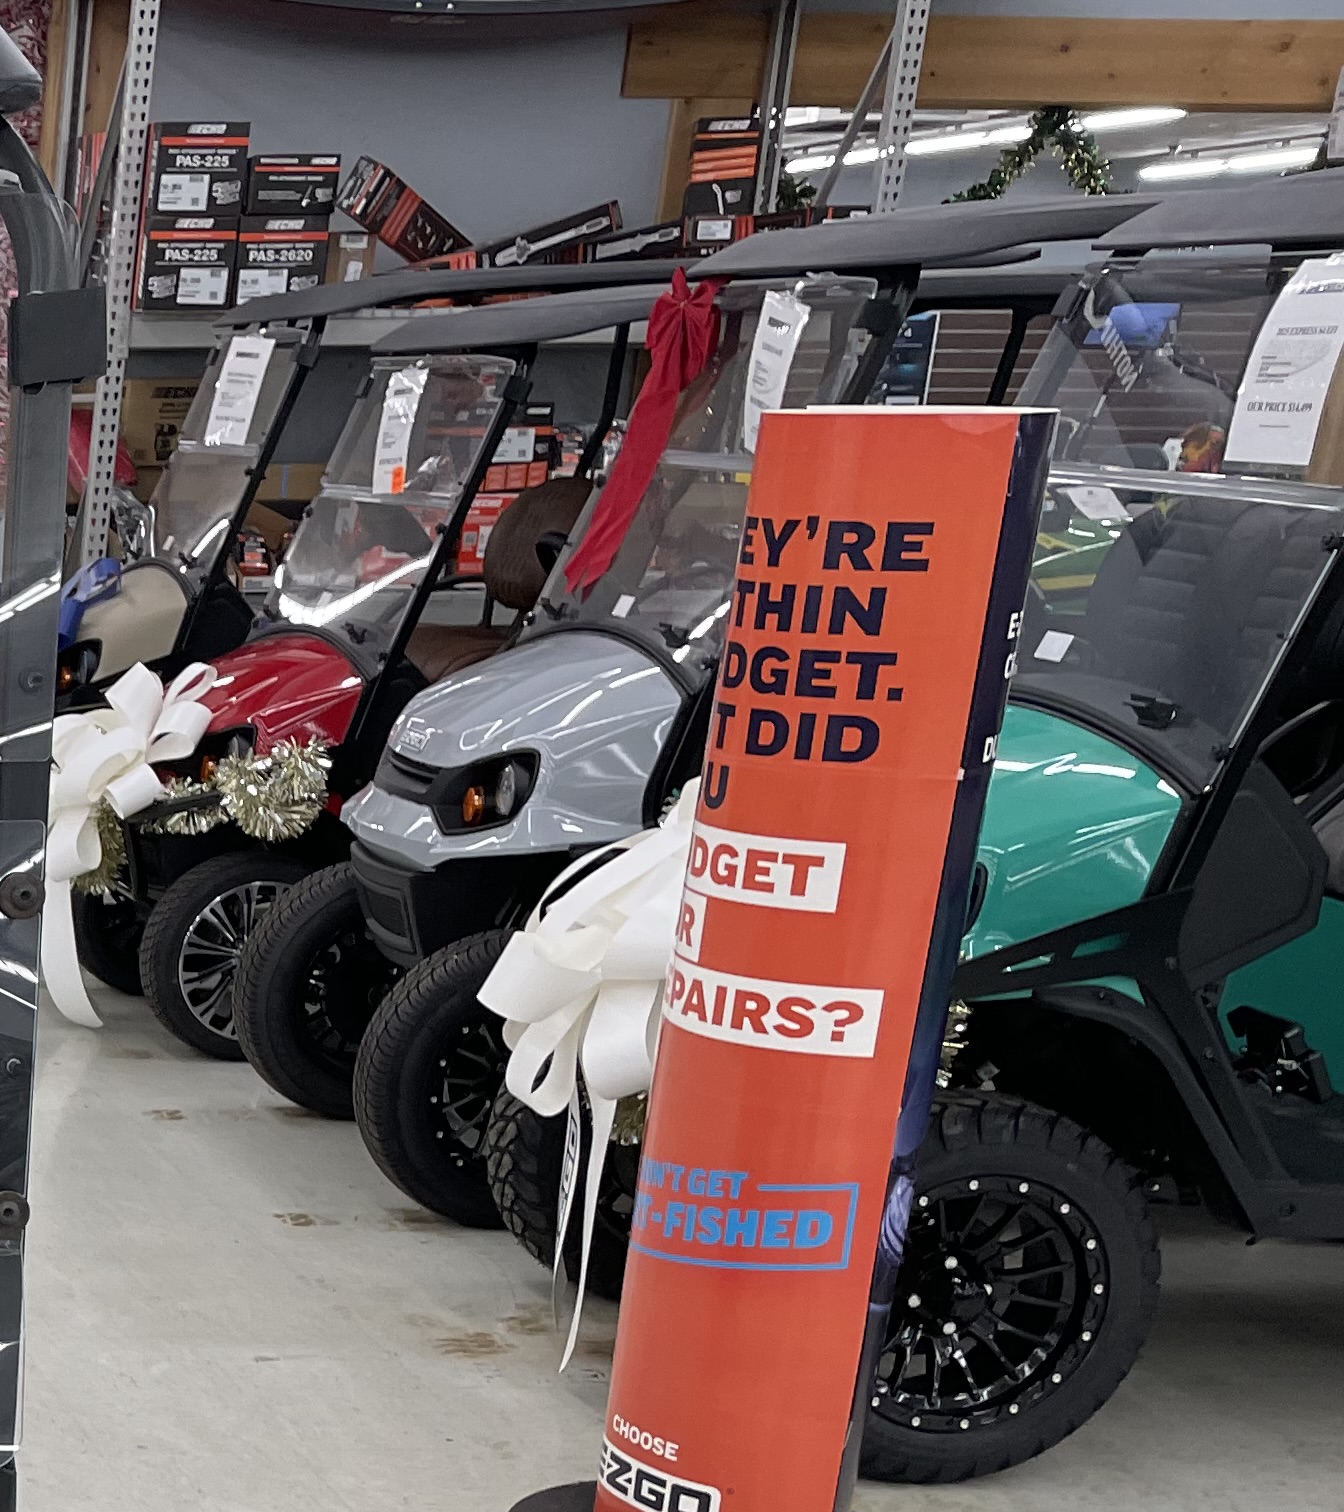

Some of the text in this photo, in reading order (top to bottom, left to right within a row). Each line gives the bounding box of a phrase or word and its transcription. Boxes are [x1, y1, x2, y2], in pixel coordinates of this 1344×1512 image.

[175, 155, 230, 167] PAS-225
[164, 249, 218, 261] PAS-225
[1263, 402, 1287, 412] PRICE
[735, 579, 888, 636] THIN
[722, 642, 904, 702] DGET.
[745, 708, 881, 763] DID
[690, 833, 825, 897] DGET
[675, 902, 696, 948] R
[688, 1167, 748, 1199] GET
[613, 1414, 679, 1462] CHOOSE
